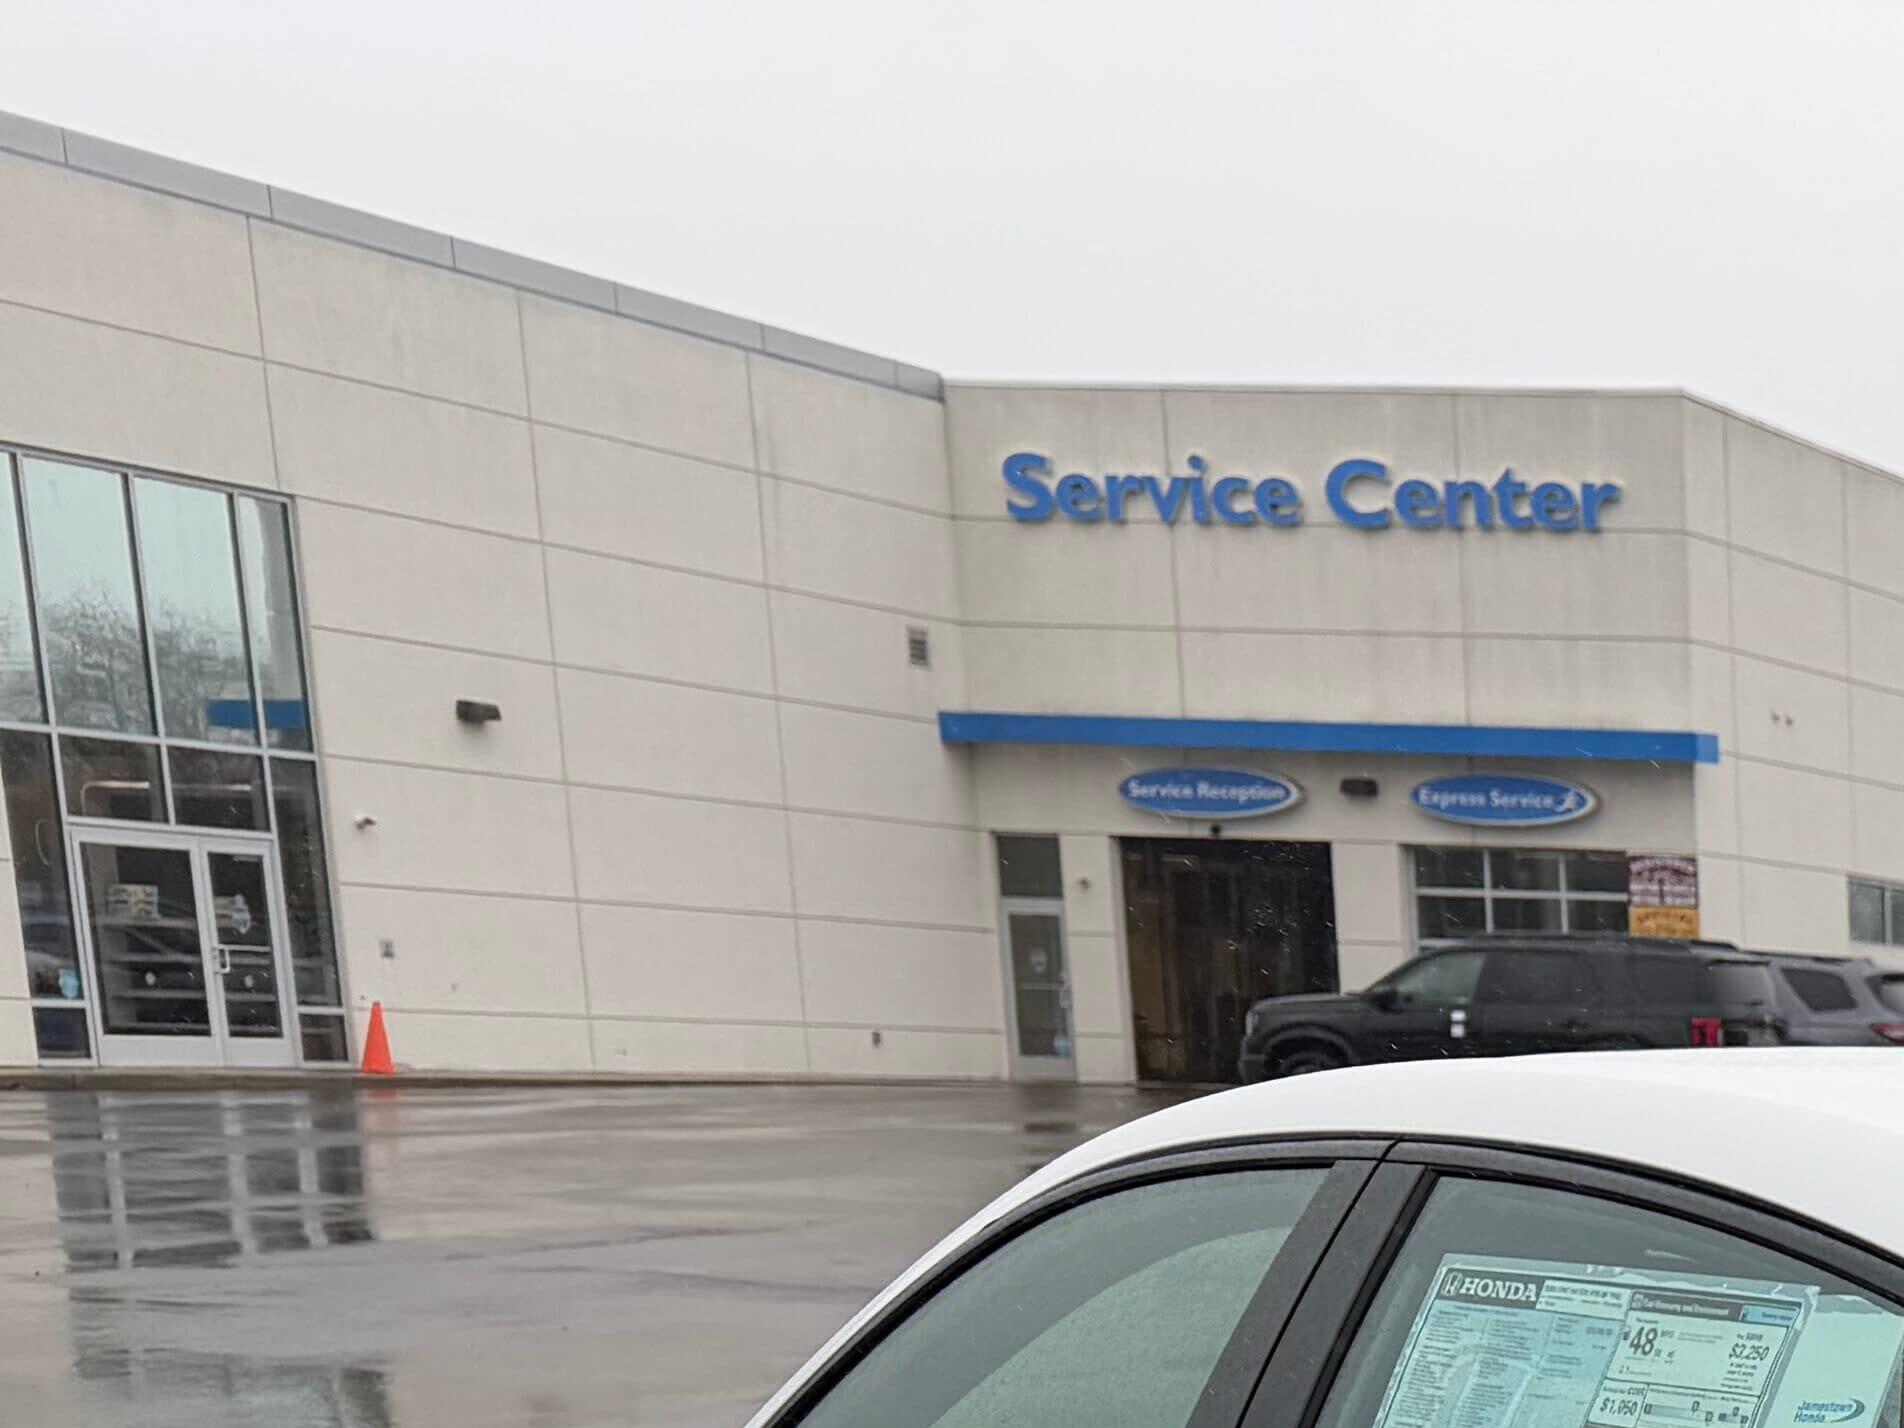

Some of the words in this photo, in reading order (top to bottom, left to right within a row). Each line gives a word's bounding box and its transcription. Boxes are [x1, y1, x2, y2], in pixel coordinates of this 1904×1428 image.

[1003, 452, 1302, 529] Service
[1325, 457, 1623, 532] Center
[1127, 779, 1193, 800] Service
[1196, 782, 1287, 808] Reception
[1419, 786, 1486, 811] Express
[1489, 789, 1556, 809] Service
[1460, 1277, 1538, 1302] HONDA
[1629, 1325, 1659, 1357] 48
[1793, 1411, 1826, 1424] Honda
[1797, 1399, 1854, 1414] Jamestown
